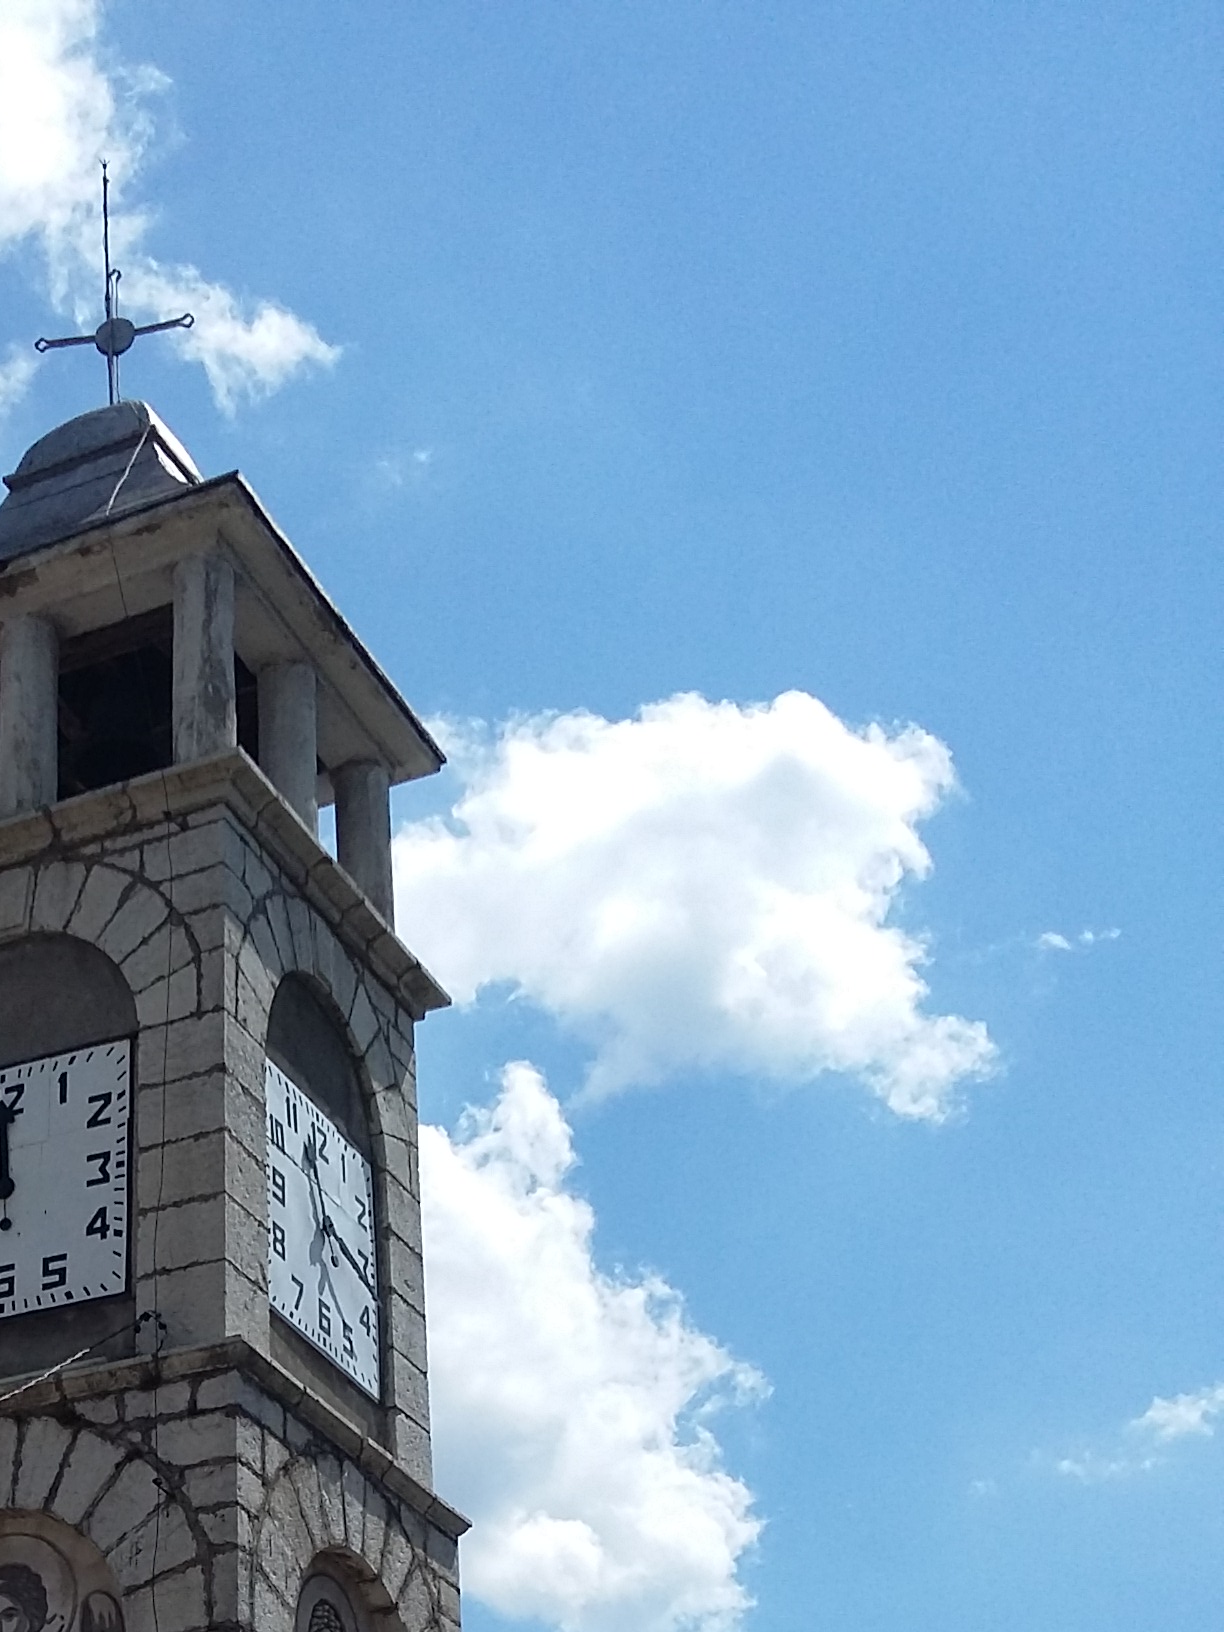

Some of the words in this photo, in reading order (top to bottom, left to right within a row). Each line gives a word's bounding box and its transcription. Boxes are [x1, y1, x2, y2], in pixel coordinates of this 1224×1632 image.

[58, 1072, 67, 1104] 1
[86, 1091, 112, 1129] 2
[285, 1096, 298, 1134] 11
[269, 1113, 285, 1154] 10
[86, 1150, 110, 1188] 3
[272, 1165, 286, 1208] 9
[85, 1206, 110, 1240] 4
[272, 1220, 286, 1262] 8
[42, 1253, 67, 1291] 5
[291, 1274, 304, 1311] 7
[319, 1298, 331, 1338] 6
